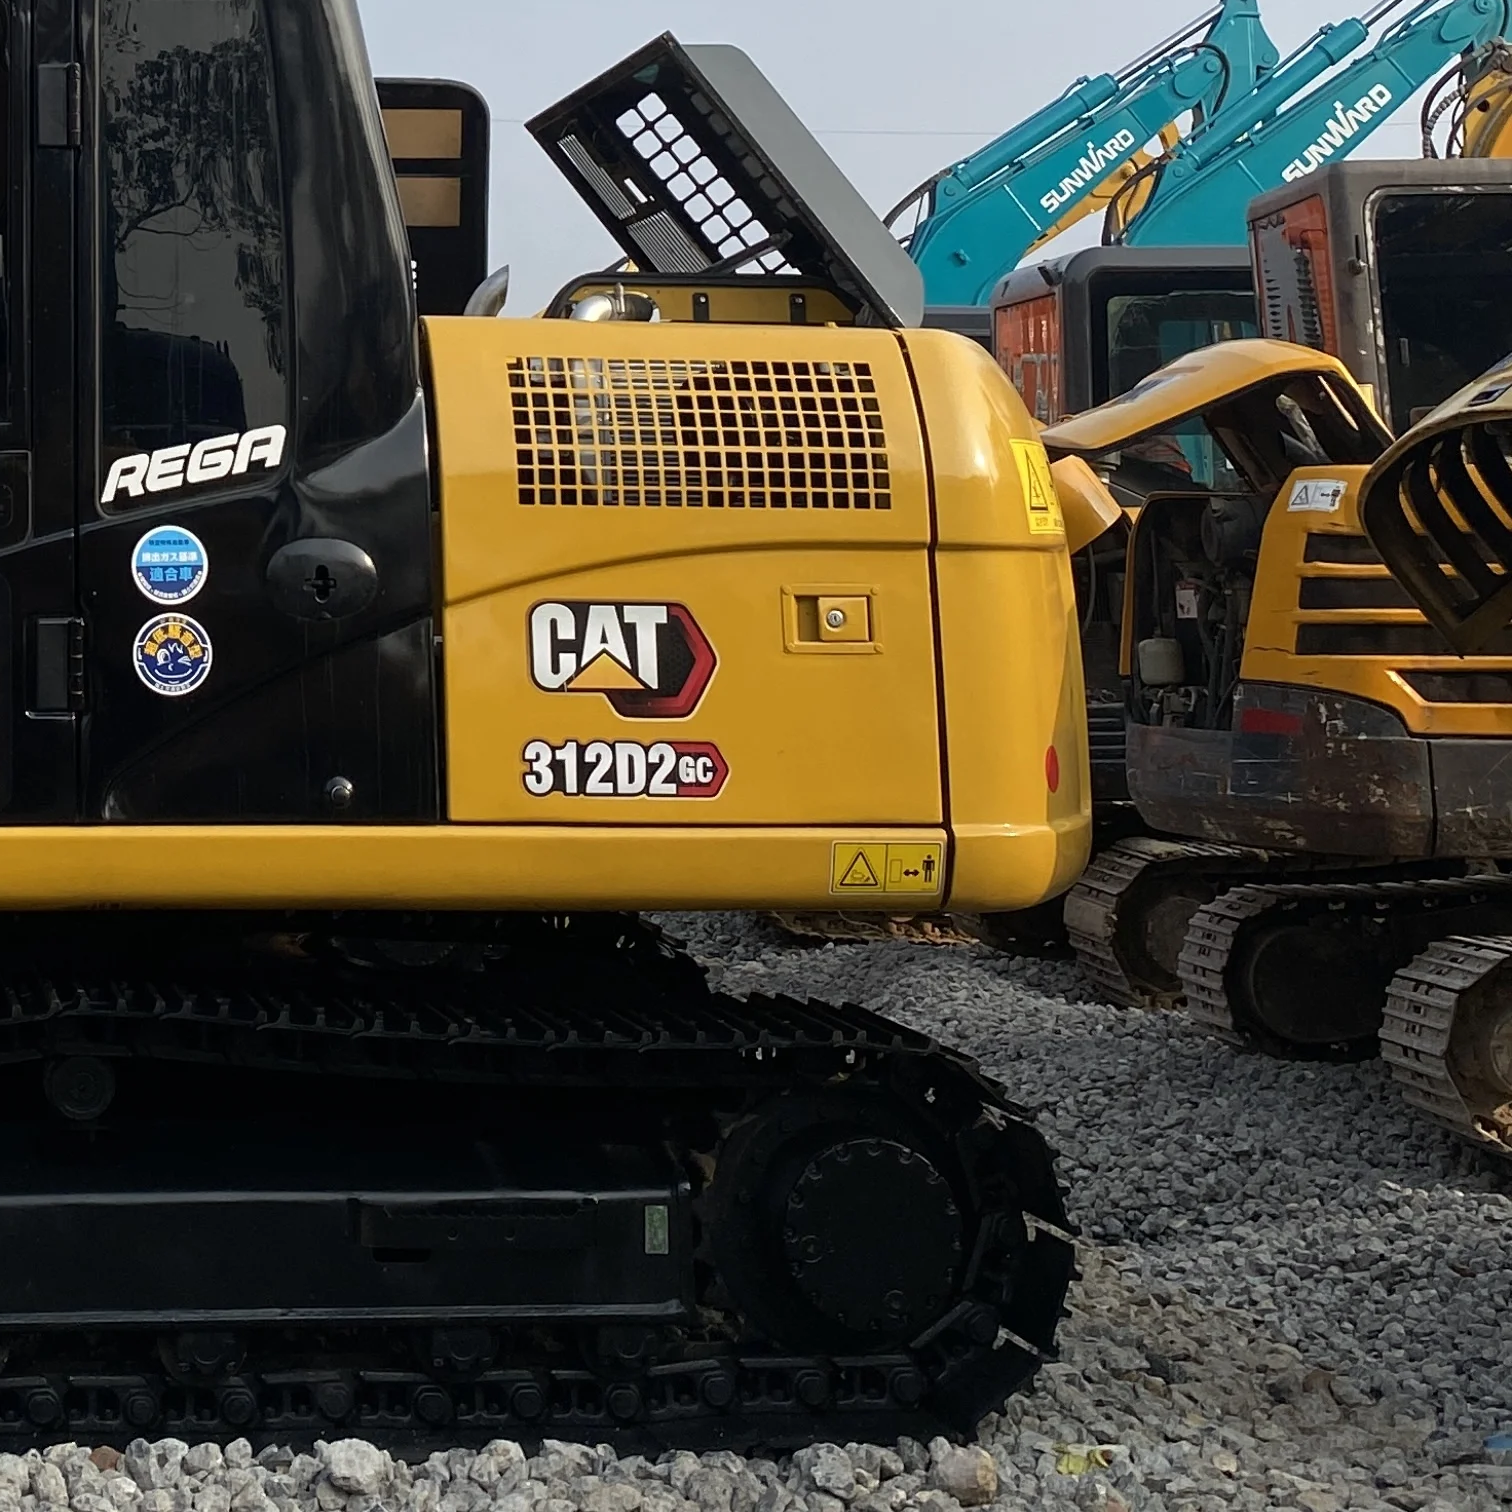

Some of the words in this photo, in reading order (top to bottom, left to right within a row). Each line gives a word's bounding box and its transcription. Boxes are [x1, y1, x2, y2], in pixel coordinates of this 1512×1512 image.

[1040, 129, 1135, 213] SUNWARD
[1281, 83, 1392, 182] SUNWARD
[101, 424, 287, 503] REGA
[150, 567, 192, 581] 適合車
[532, 603, 668, 689] CAT
